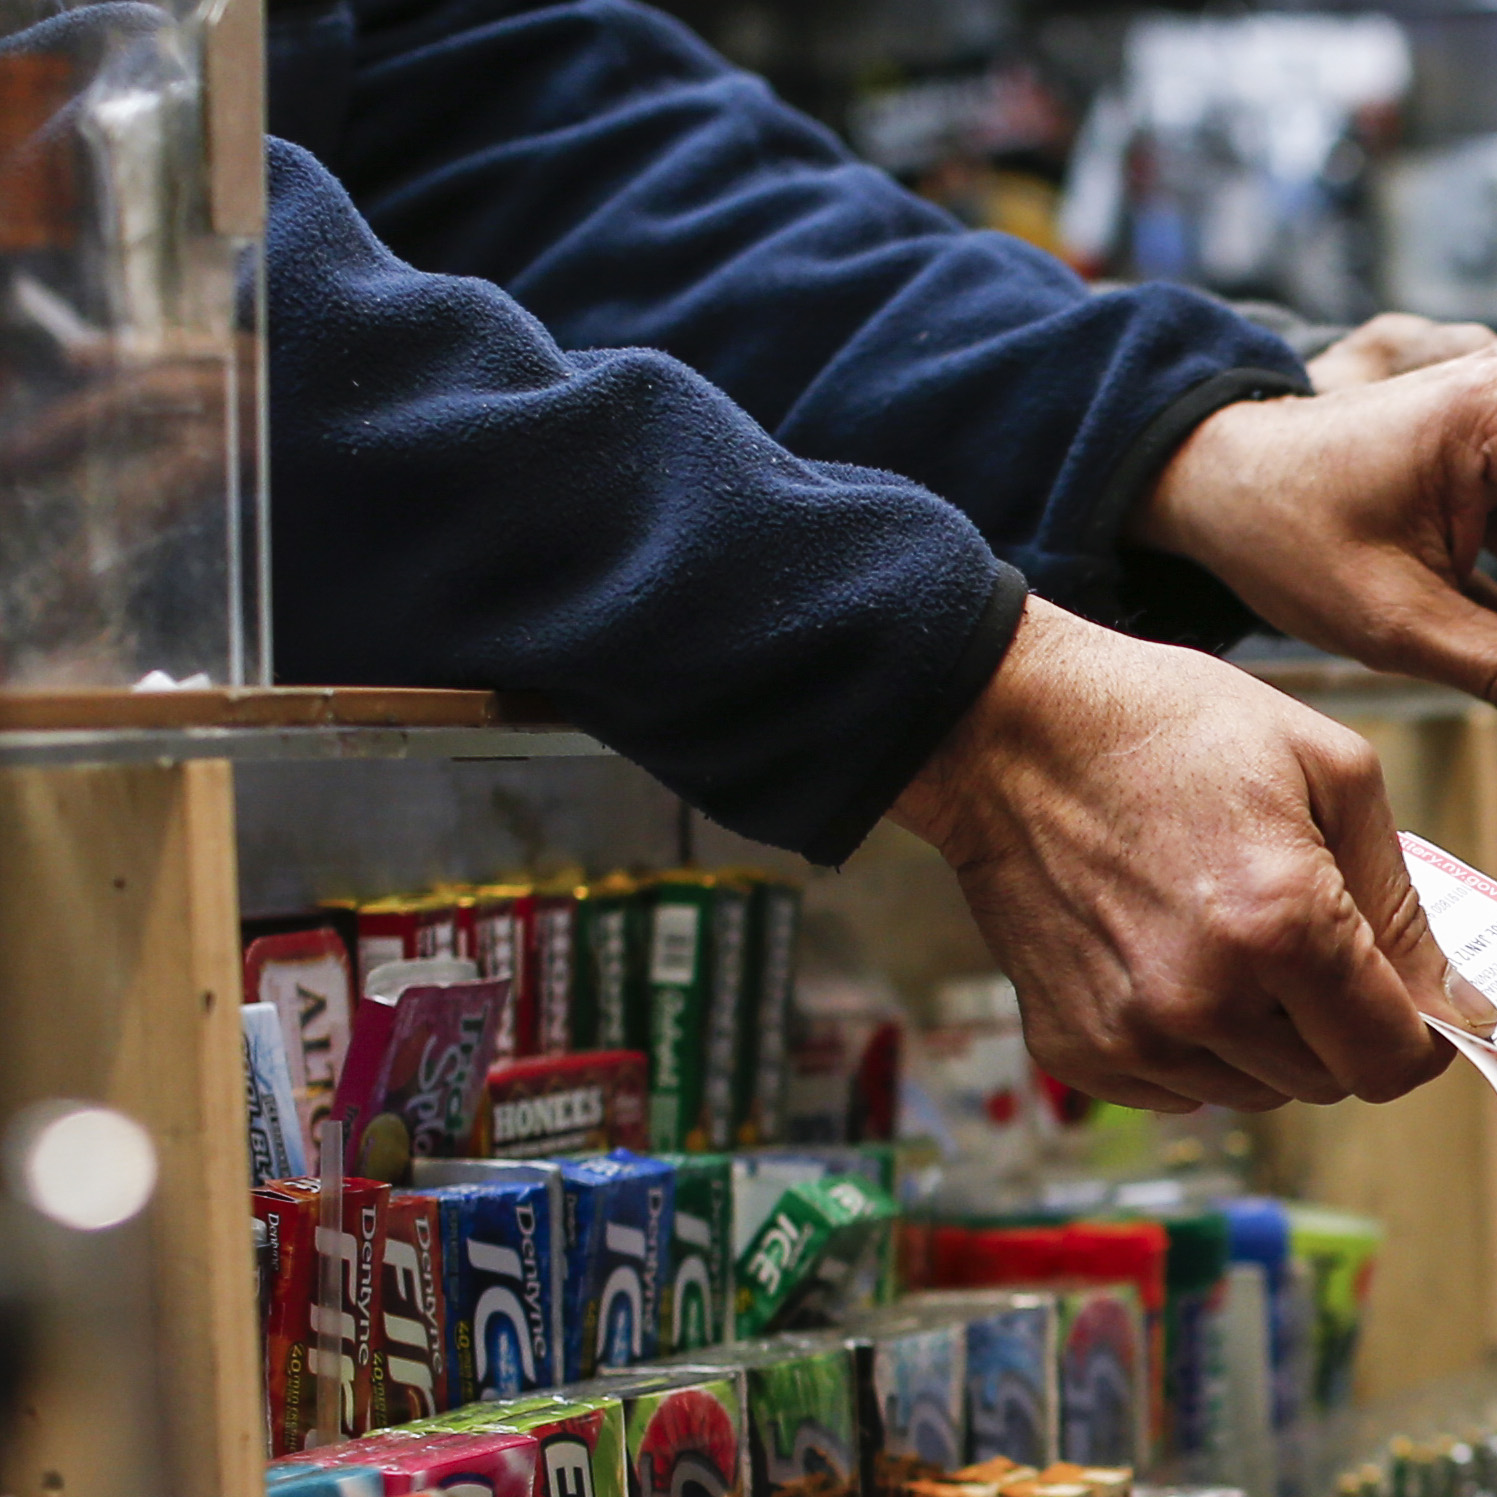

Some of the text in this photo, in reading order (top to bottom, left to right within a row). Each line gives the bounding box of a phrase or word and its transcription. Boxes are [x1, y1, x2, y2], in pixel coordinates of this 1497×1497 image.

[1454, 932, 1491, 965] JAN12
[356, 1203, 378, 1367] Dentyne
[415, 1215, 444, 1376] Dentyne
[516, 1203, 547, 1360] Dentyne
[747, 1213, 800, 1297] ICE
